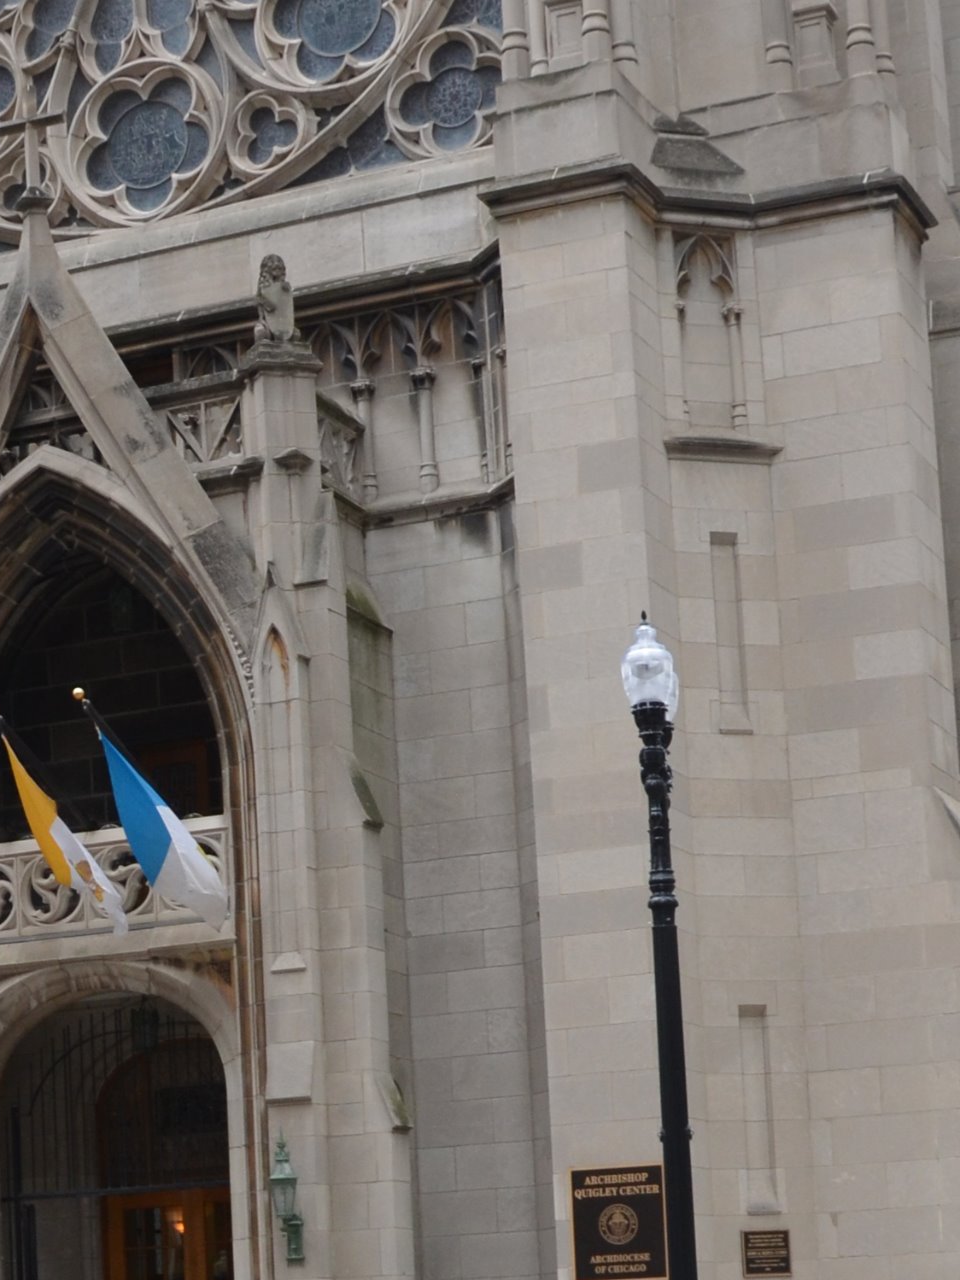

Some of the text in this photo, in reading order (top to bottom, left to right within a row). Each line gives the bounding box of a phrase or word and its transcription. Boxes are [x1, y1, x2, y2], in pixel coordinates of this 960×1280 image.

[584, 1172, 649, 1186] ARCHBISHOP
[574, 1184, 660, 1200] QUIGLEY CENTER
[590, 1252, 651, 1264] ARCHDIOCESE
[595, 1263, 647, 1274] OF CHICAGO
